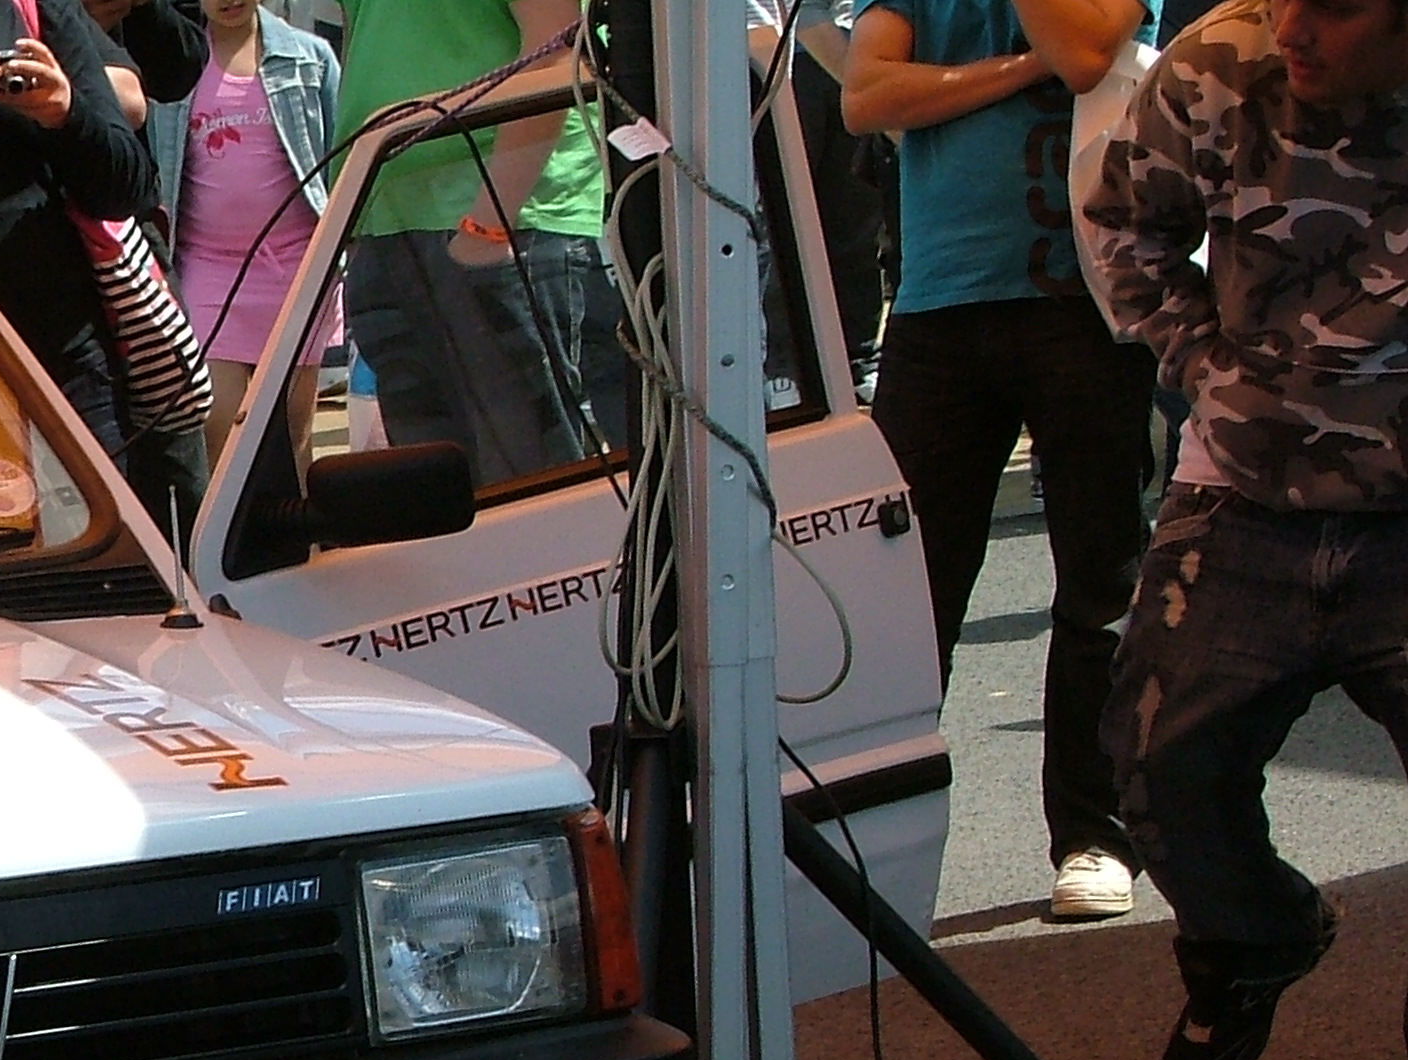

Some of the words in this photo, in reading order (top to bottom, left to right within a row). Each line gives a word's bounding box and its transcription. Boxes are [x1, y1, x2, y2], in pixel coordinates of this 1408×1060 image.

[369, 595, 504, 659] HERTZ
[20, 672, 290, 792] HERTZ
[221, 877, 318, 913] FIAT
